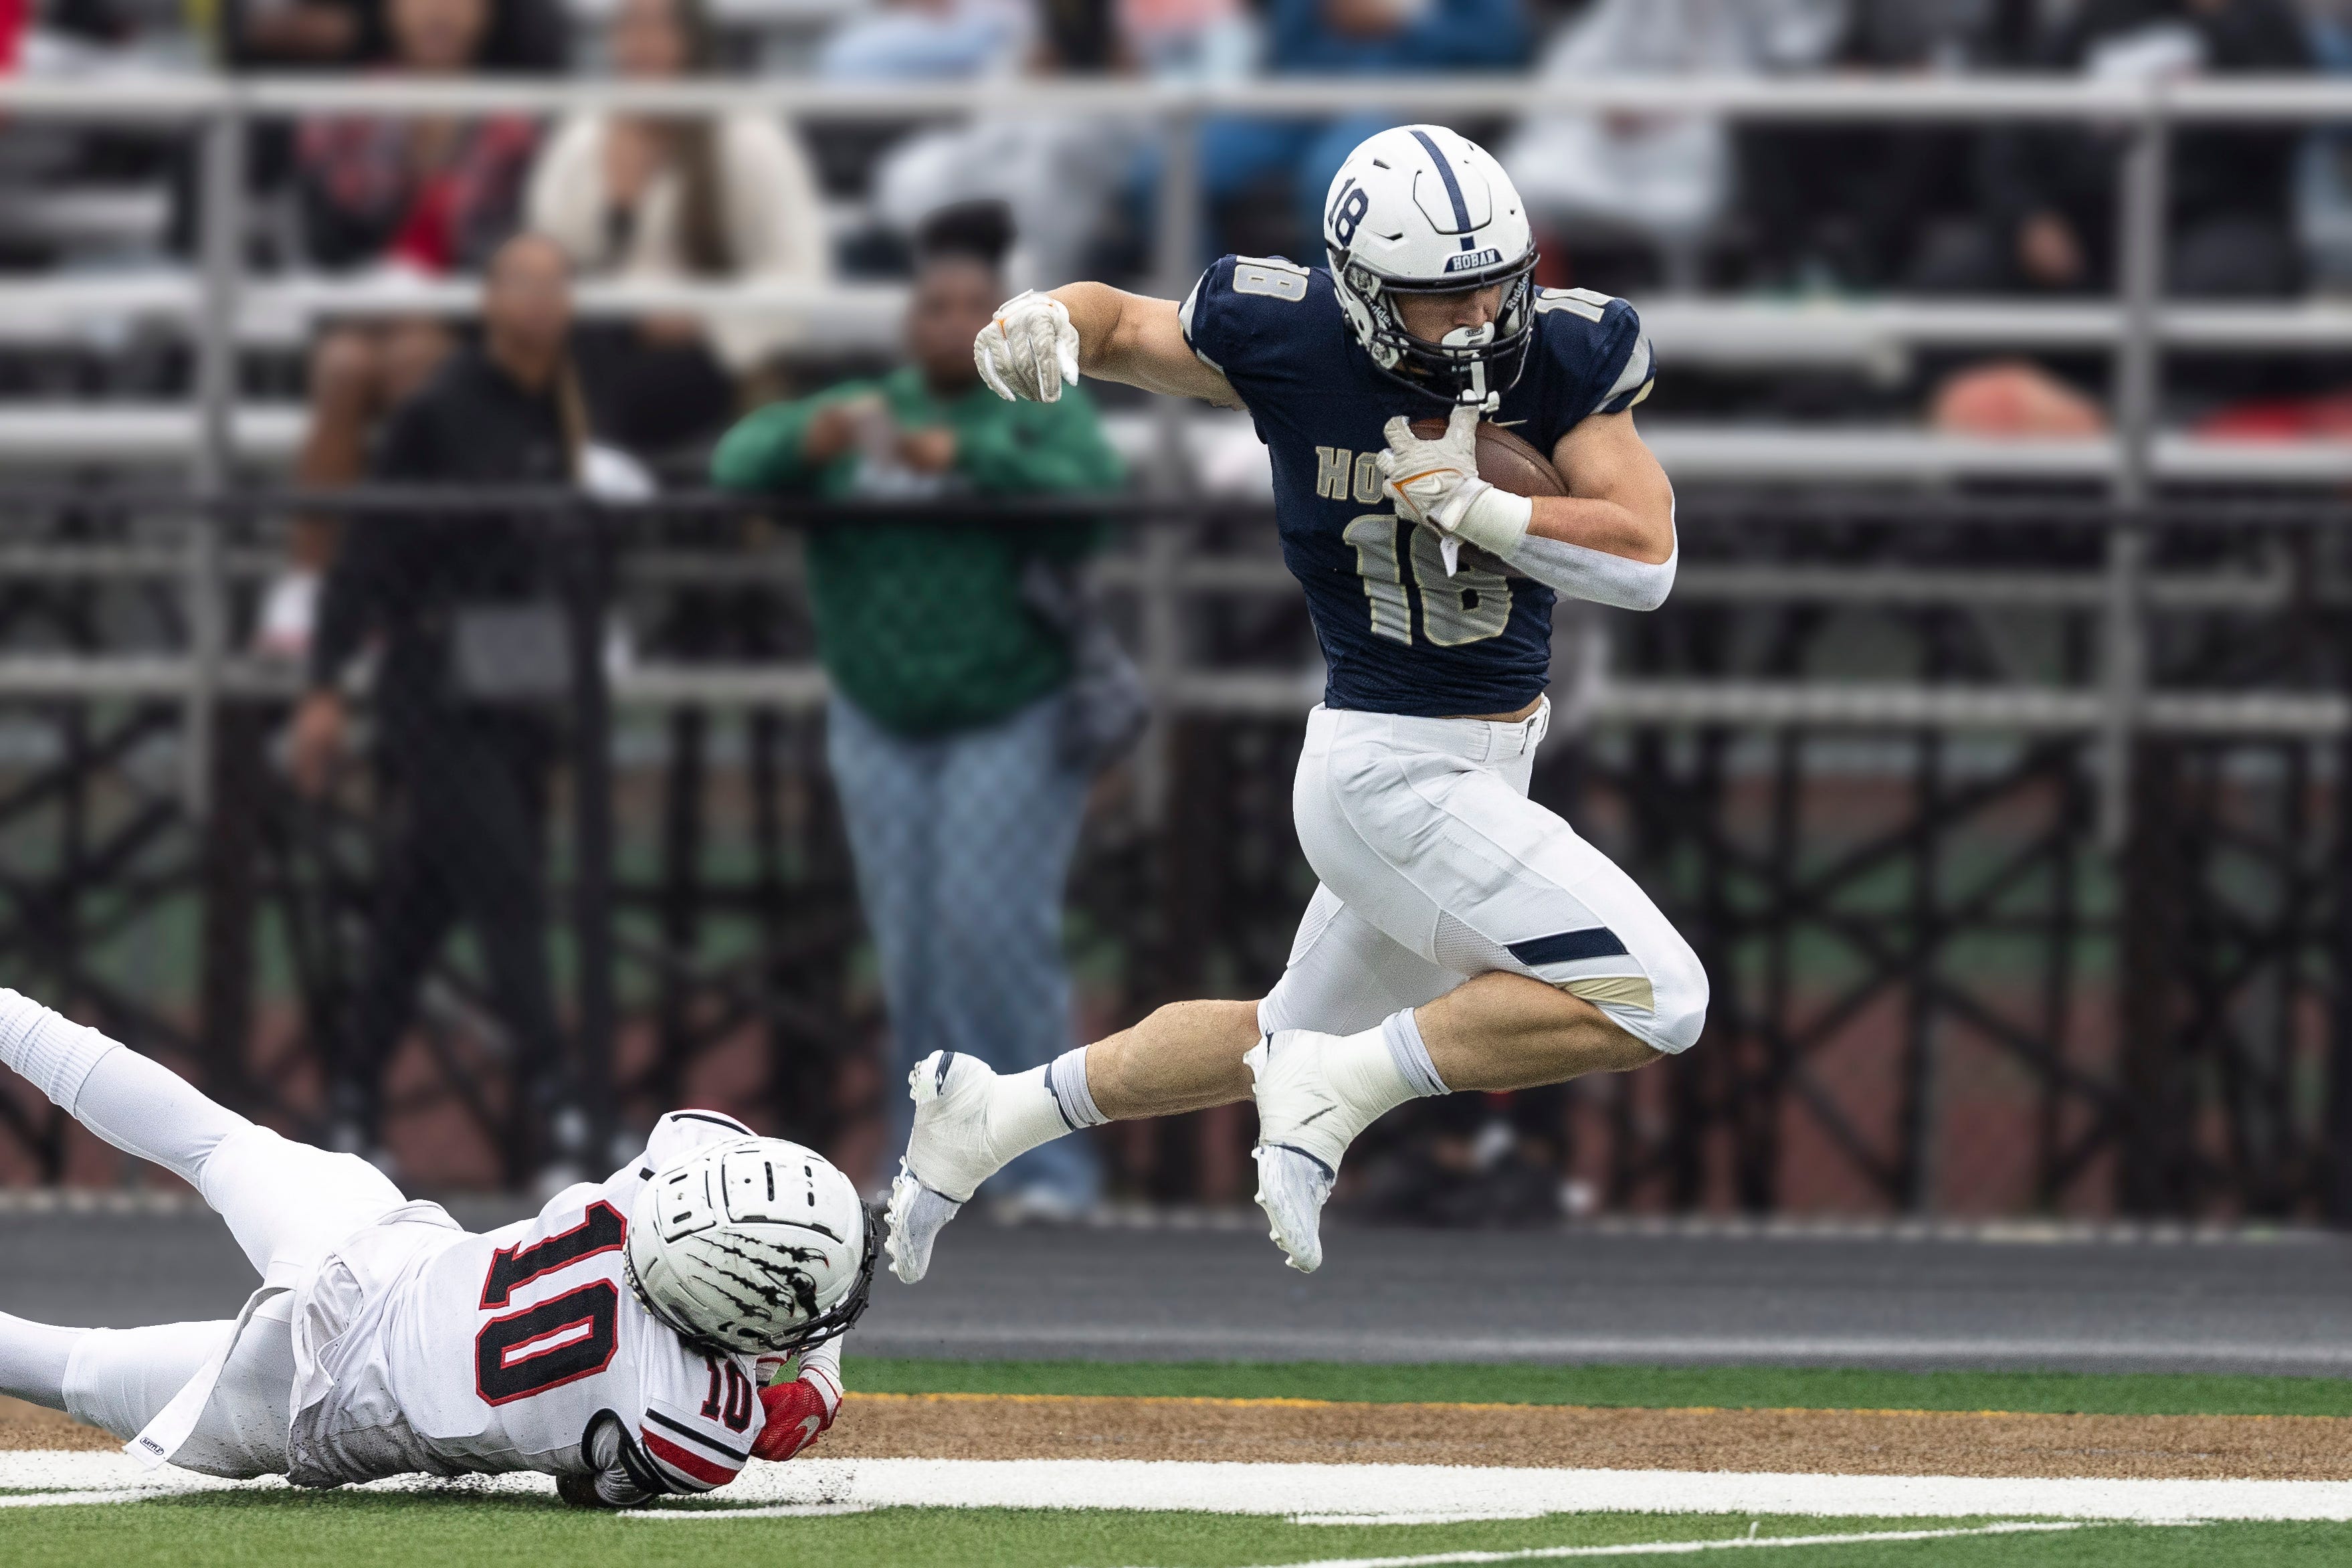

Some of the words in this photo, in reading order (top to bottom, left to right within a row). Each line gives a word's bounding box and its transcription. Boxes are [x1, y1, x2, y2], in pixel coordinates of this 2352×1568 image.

[1328, 177, 1369, 248] 18
[1452, 250, 1496, 270] HOBAN
[476, 1199, 627, 1407] 10
[700, 1353, 753, 1434] 10
